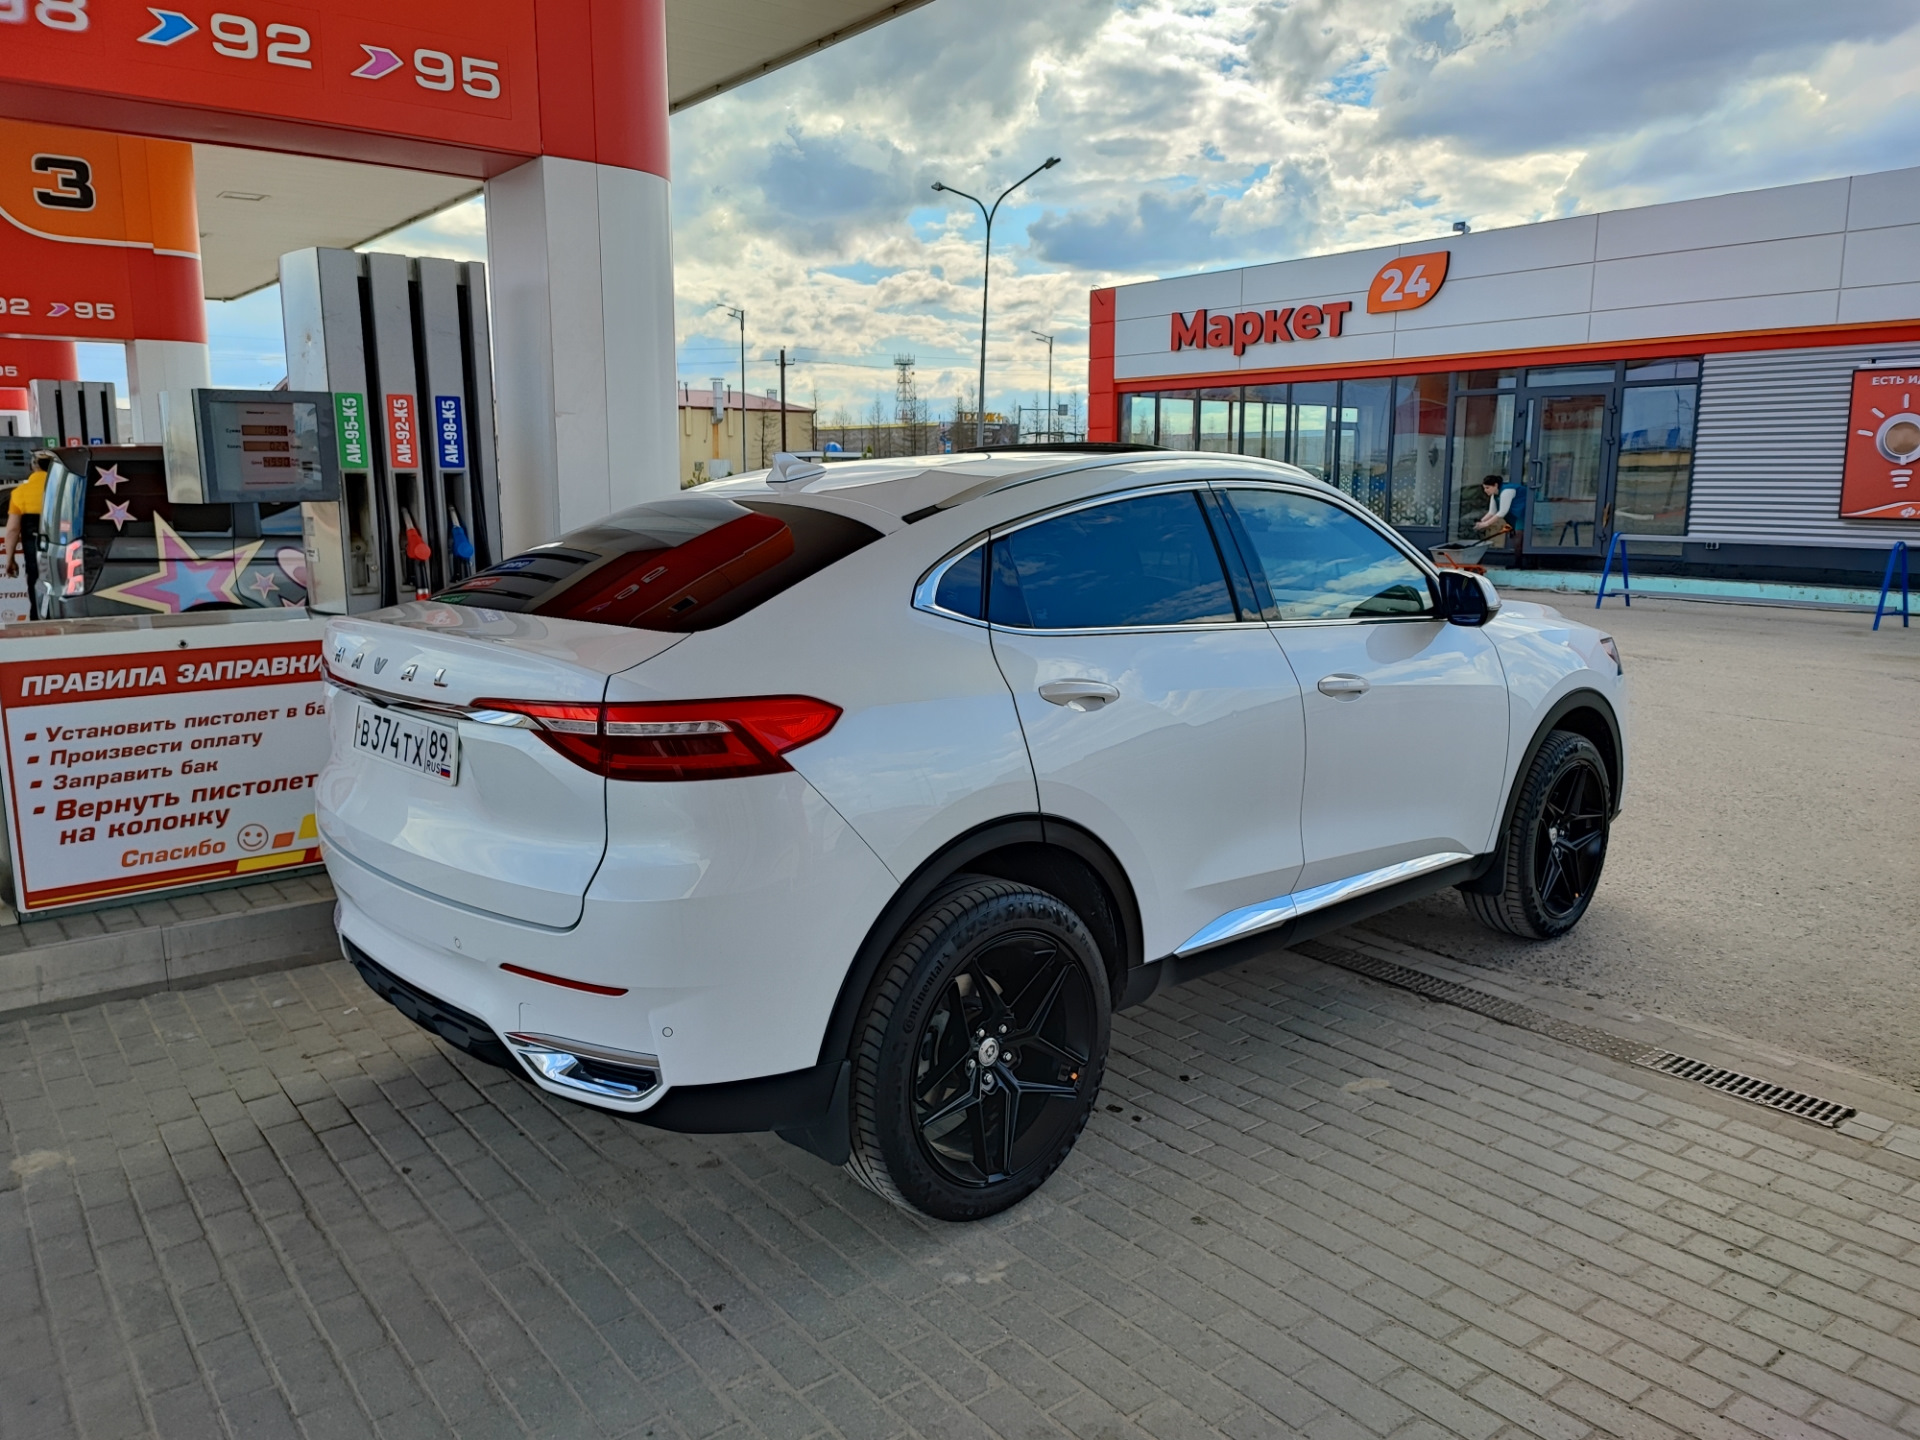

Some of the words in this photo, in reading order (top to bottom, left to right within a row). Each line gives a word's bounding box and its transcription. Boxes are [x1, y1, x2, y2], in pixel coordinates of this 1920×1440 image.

[0, 0, 89, 32] 8
[210, 12, 312, 69] 92
[413, 48, 500, 99] 95
[31, 153, 96, 211] 3
[1381, 265, 1430, 302] 24
[74, 302, 115, 320] 95
[1171, 301, 1352, 356] Маркет
[0, 365, 18, 377] 5
[1872, 375, 1905, 386] ЕСТЬ
[342, 397, 362, 463] АИ-95-К5
[393, 398, 412, 463] АИ-92-К5
[441, 400, 459, 463] АИ-98-К5
[21, 666, 167, 697] ПРАВИЛА
[176, 654, 323, 684] ЗАПРАВКИ
[334, 647, 448, 687] HAVAL
[46, 720, 176, 742] Установить
[184, 708, 279, 728] пистолет
[286, 707, 297, 718] в
[305, 702, 326, 716] ба
[50, 741, 182, 768] Произвести
[190, 732, 263, 750] оплату
[426, 760, 440, 774] RUS
[53, 767, 173, 789] Заправить
[181, 759, 218, 775] бак
[55, 792, 180, 822] Вернуть
[191, 773, 319, 803] пистолет
[60, 827, 95, 845] на
[108, 808, 230, 838] колонку
[121, 839, 226, 867] Спасибо
